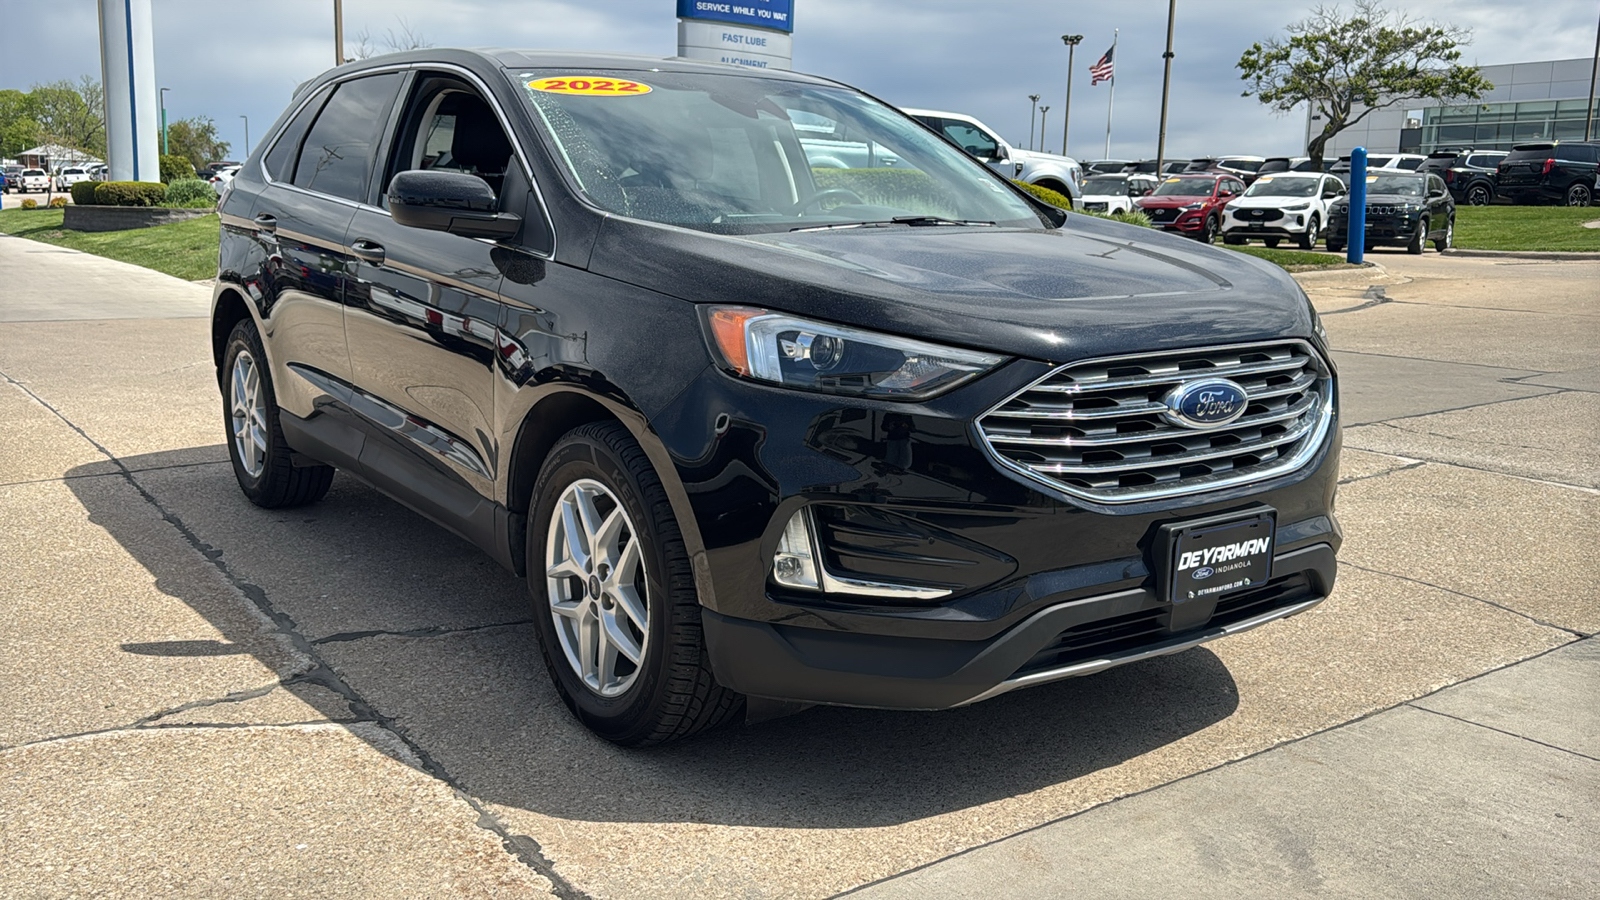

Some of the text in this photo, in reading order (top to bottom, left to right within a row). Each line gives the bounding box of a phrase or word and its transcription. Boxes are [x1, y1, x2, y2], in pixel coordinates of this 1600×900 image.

[696, 2, 787, 21] SERVICE WHILE YOU WAIT
[722, 33, 767, 47] FAST LUBE
[544, 80, 640, 92] 2022
[1196, 390, 1235, 417] Ford
[611, 468, 651, 541] KELLY
[1178, 537, 1270, 571] DEYARMAN
[1215, 560, 1252, 574] INDIANOLA
[1197, 580, 1243, 596] DEYARMANFORD.COM
